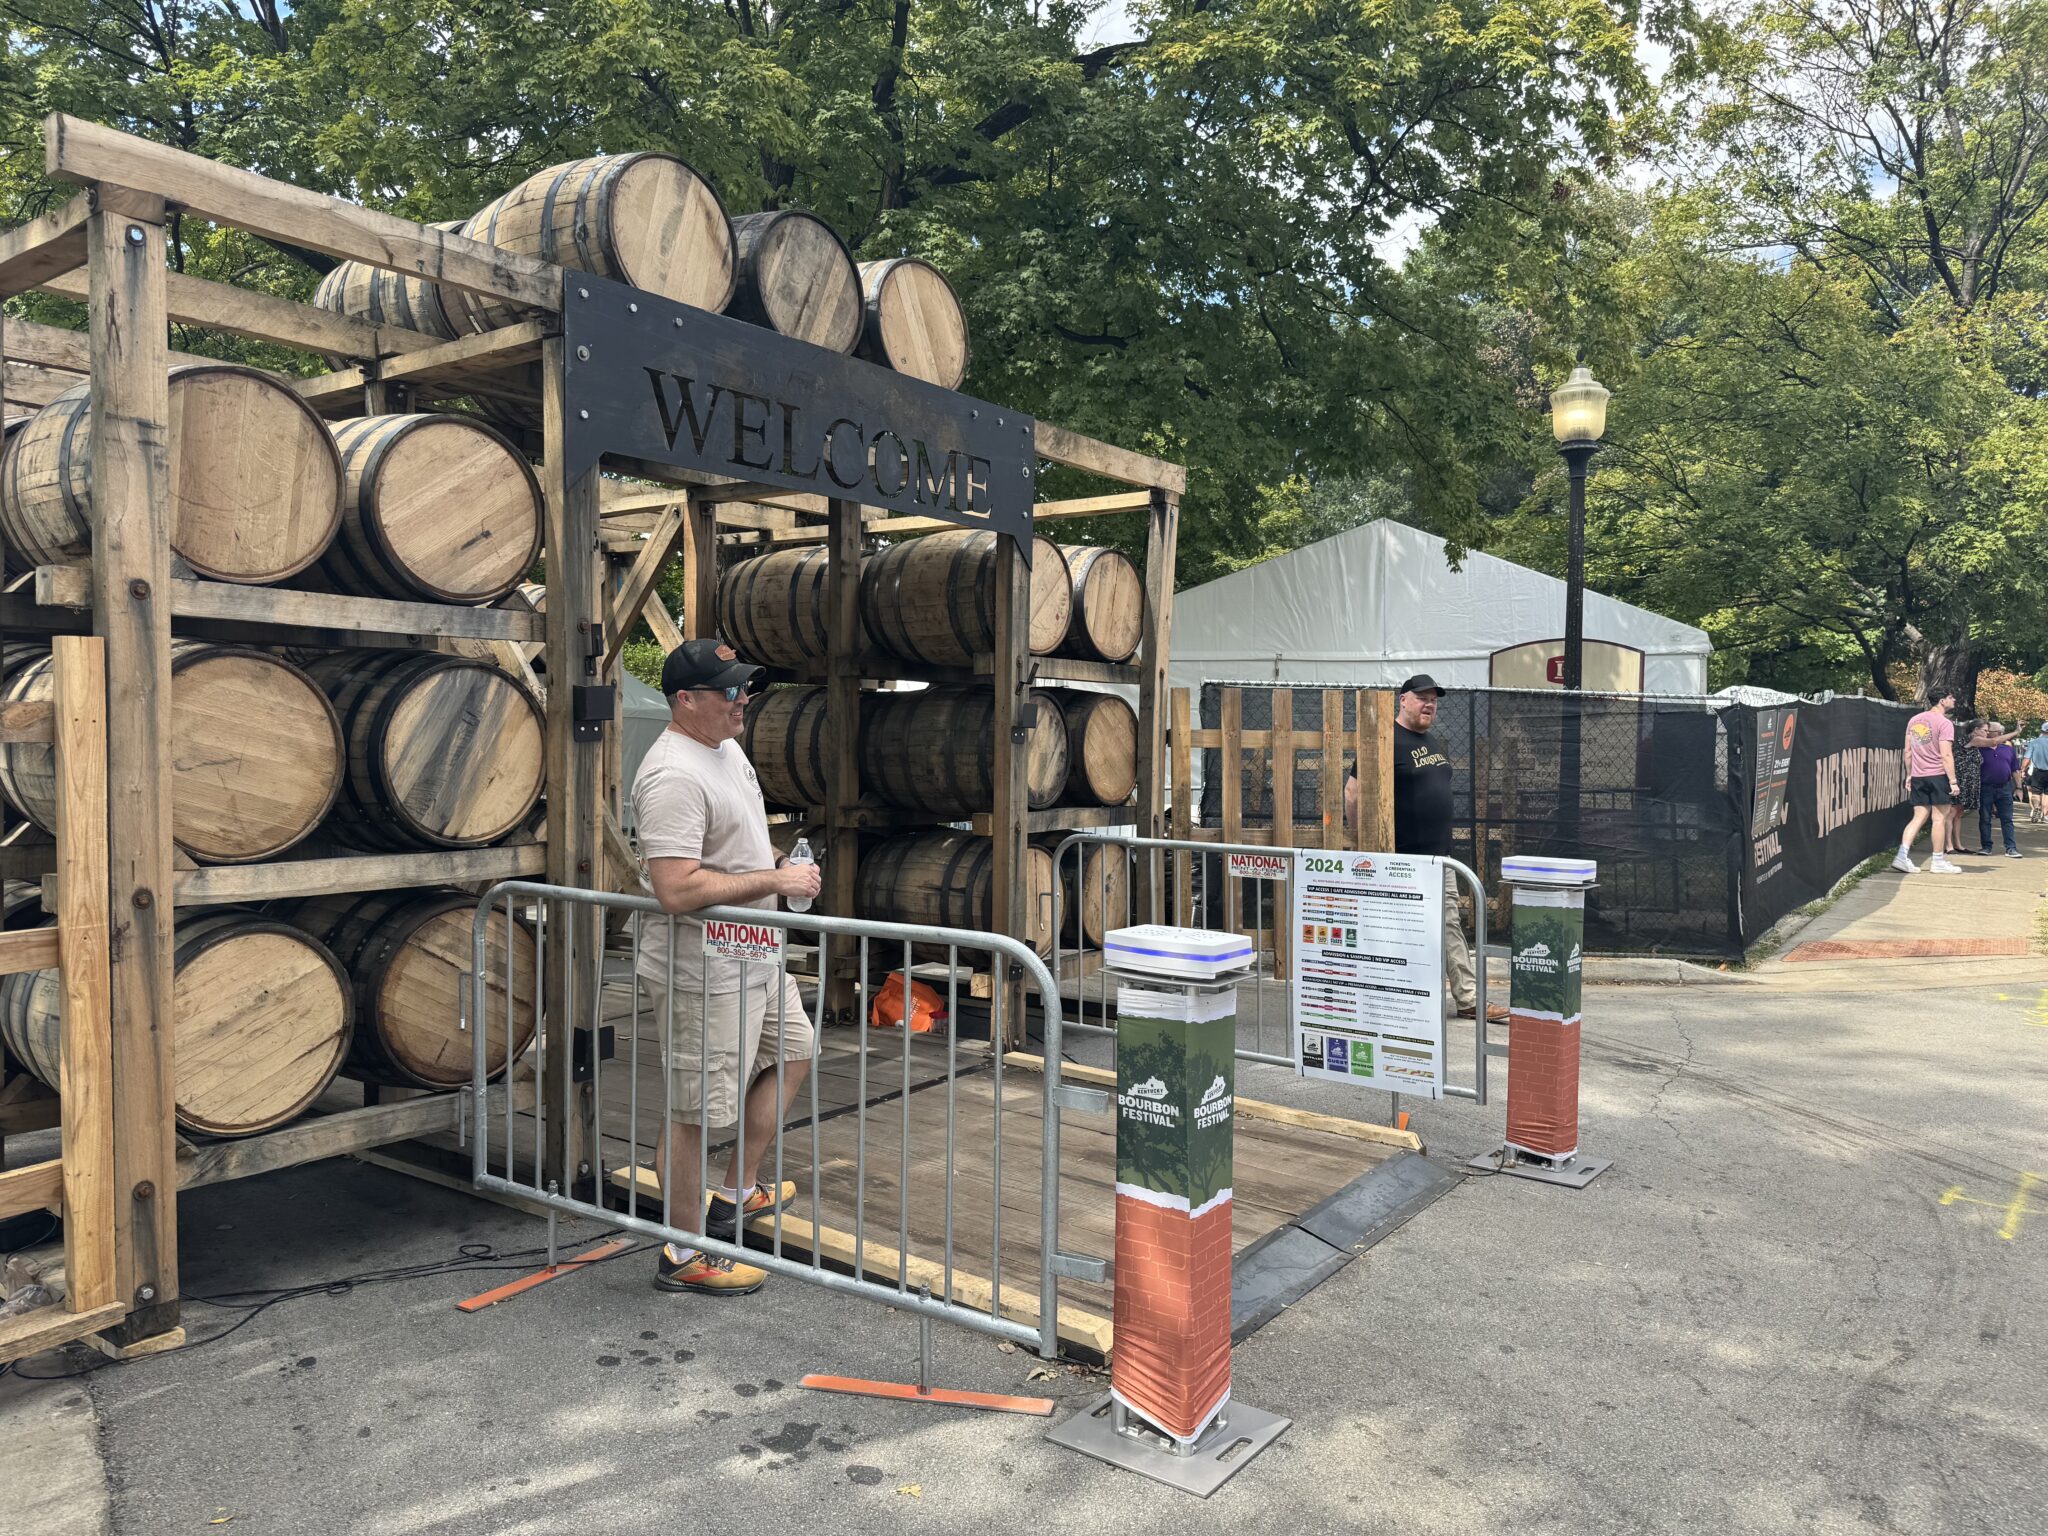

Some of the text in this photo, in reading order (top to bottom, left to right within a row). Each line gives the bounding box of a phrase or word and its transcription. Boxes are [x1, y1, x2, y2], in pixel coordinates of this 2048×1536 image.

[643, 366, 993, 519] WELCOME
[1411, 746, 1428, 759] OLD
[1816, 747, 1867, 838] WELCOME
[1755, 831, 1782, 868] FESTIVAL
[1231, 855, 1286, 870] NATIONAL
[1305, 858, 1344, 874] 2024
[1388, 871, 1412, 879] ACCESS
[707, 921, 779, 947] NATIONAL
[706, 940, 779, 953] RENT-A-FENCE
[717, 947, 767, 959] 800-352-5675
[1512, 955, 1559, 967] BOURBON
[1137, 1087, 1164, 1095] KENTUCKY
[1118, 1094, 1180, 1117] BOURBON
[1193, 1094, 1232, 1119] BOURBON
[1122, 1106, 1176, 1129] FESTIVAL
[1197, 1108, 1230, 1130] FESTIVAL
